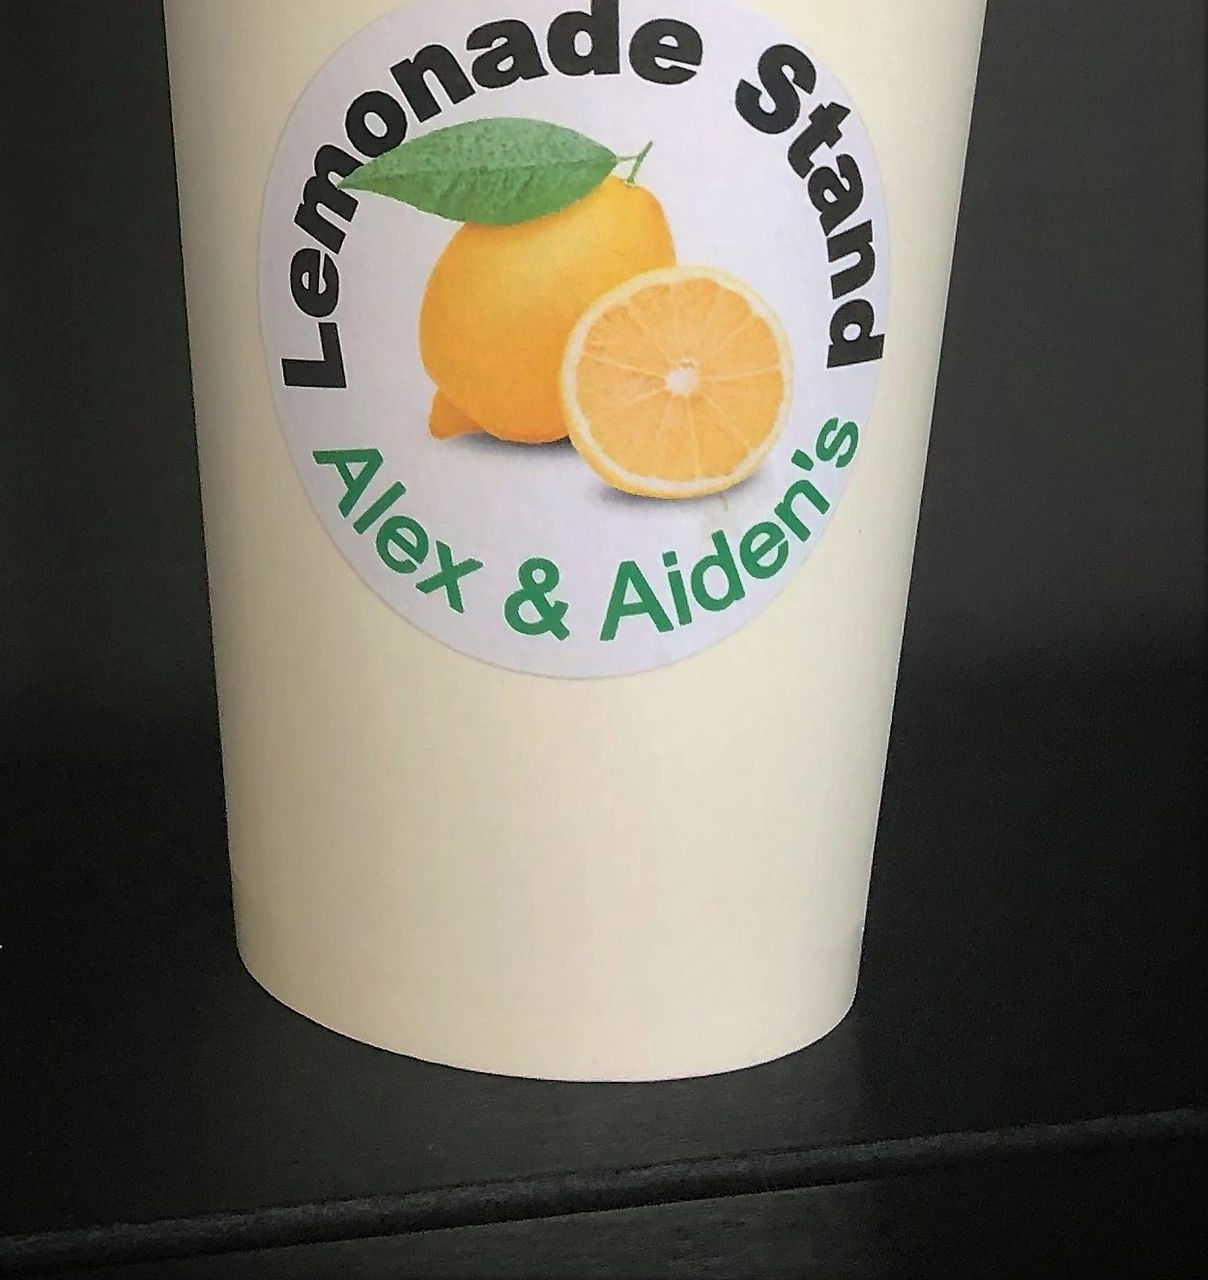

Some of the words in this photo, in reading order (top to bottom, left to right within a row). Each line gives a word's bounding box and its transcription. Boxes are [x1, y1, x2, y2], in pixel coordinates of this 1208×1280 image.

[735, 43, 885, 368] Stand
[312, 448, 483, 613] Alex
[503, 557, 571, 642] &
[599, 416, 860, 642] Aiden's
